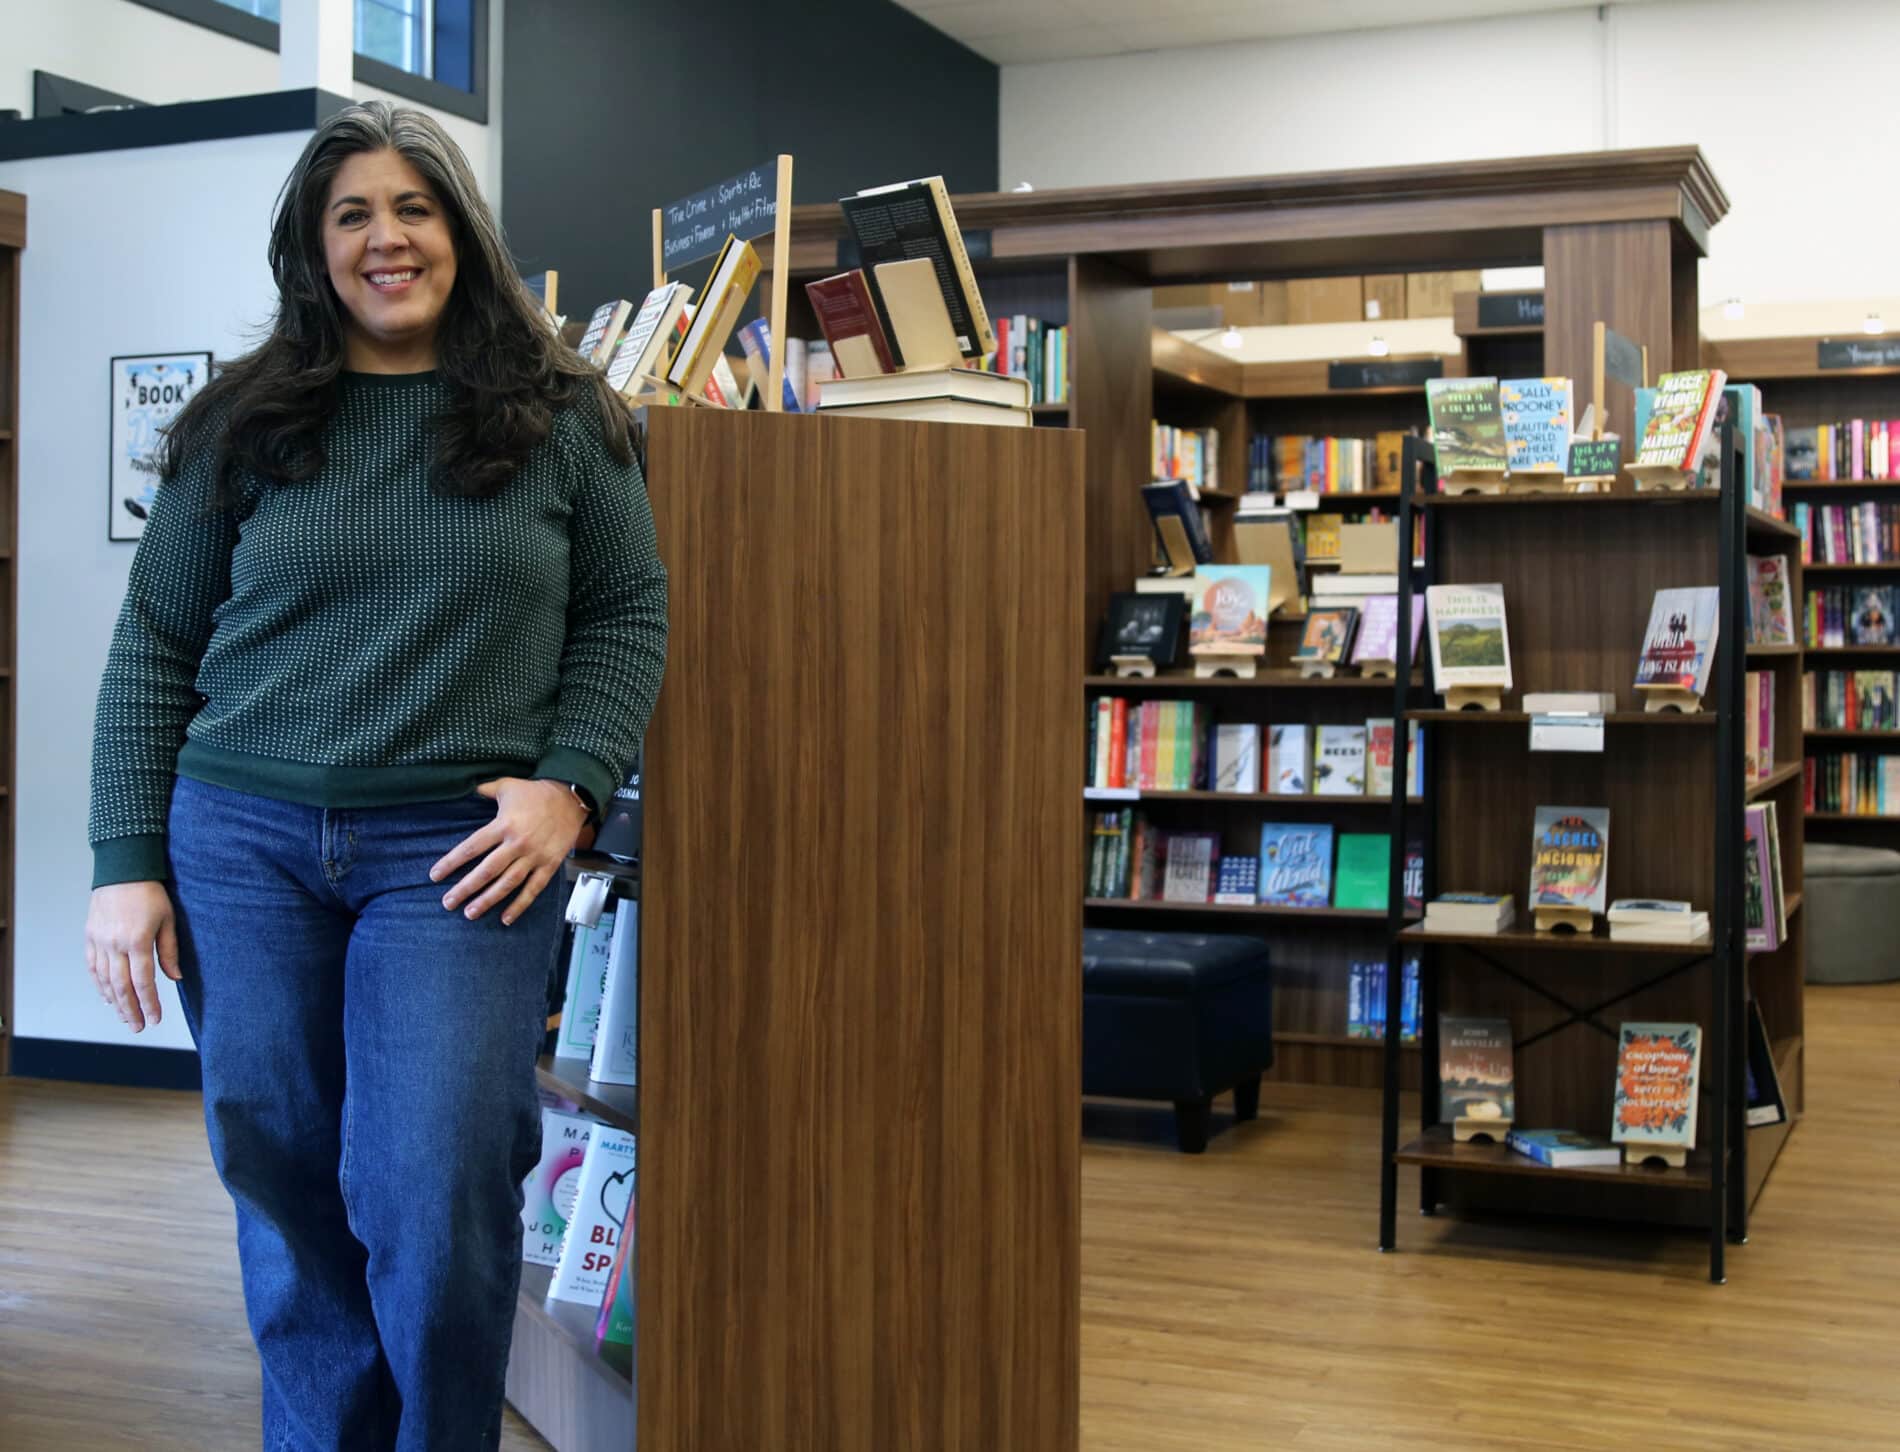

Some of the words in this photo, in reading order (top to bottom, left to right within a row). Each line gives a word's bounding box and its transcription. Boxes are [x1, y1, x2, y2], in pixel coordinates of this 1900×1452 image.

[686, 200, 707, 219] Crime
[1663, 375, 1703, 392] MAGGIE
[138, 384, 185, 405] BOOK
[1518, 386, 1552, 398] SALLY
[1506, 400, 1564, 412] ROONEY
[1507, 423, 1564, 433] BEAUTIFUL
[1641, 432, 1691, 449] MARRIAGE
[1511, 456, 1530, 465] ARE
[1535, 454, 1561, 465] YOU
[1447, 595, 1472, 604] THIS
[1435, 607, 1501, 616] HAPPINESS
[1639, 660, 1662, 674] LONG
[1664, 659, 1700, 674] ISLAND
[1543, 832, 1598, 847] RACHEL
[1536, 852, 1602, 866] INCIDENT
[1625, 1051, 1689, 1063] cacophony
[1648, 1063, 1679, 1074] bone
[564, 1127, 591, 1141] MA
[590, 1224, 616, 1246] BL
[581, 1252, 612, 1272] SP
